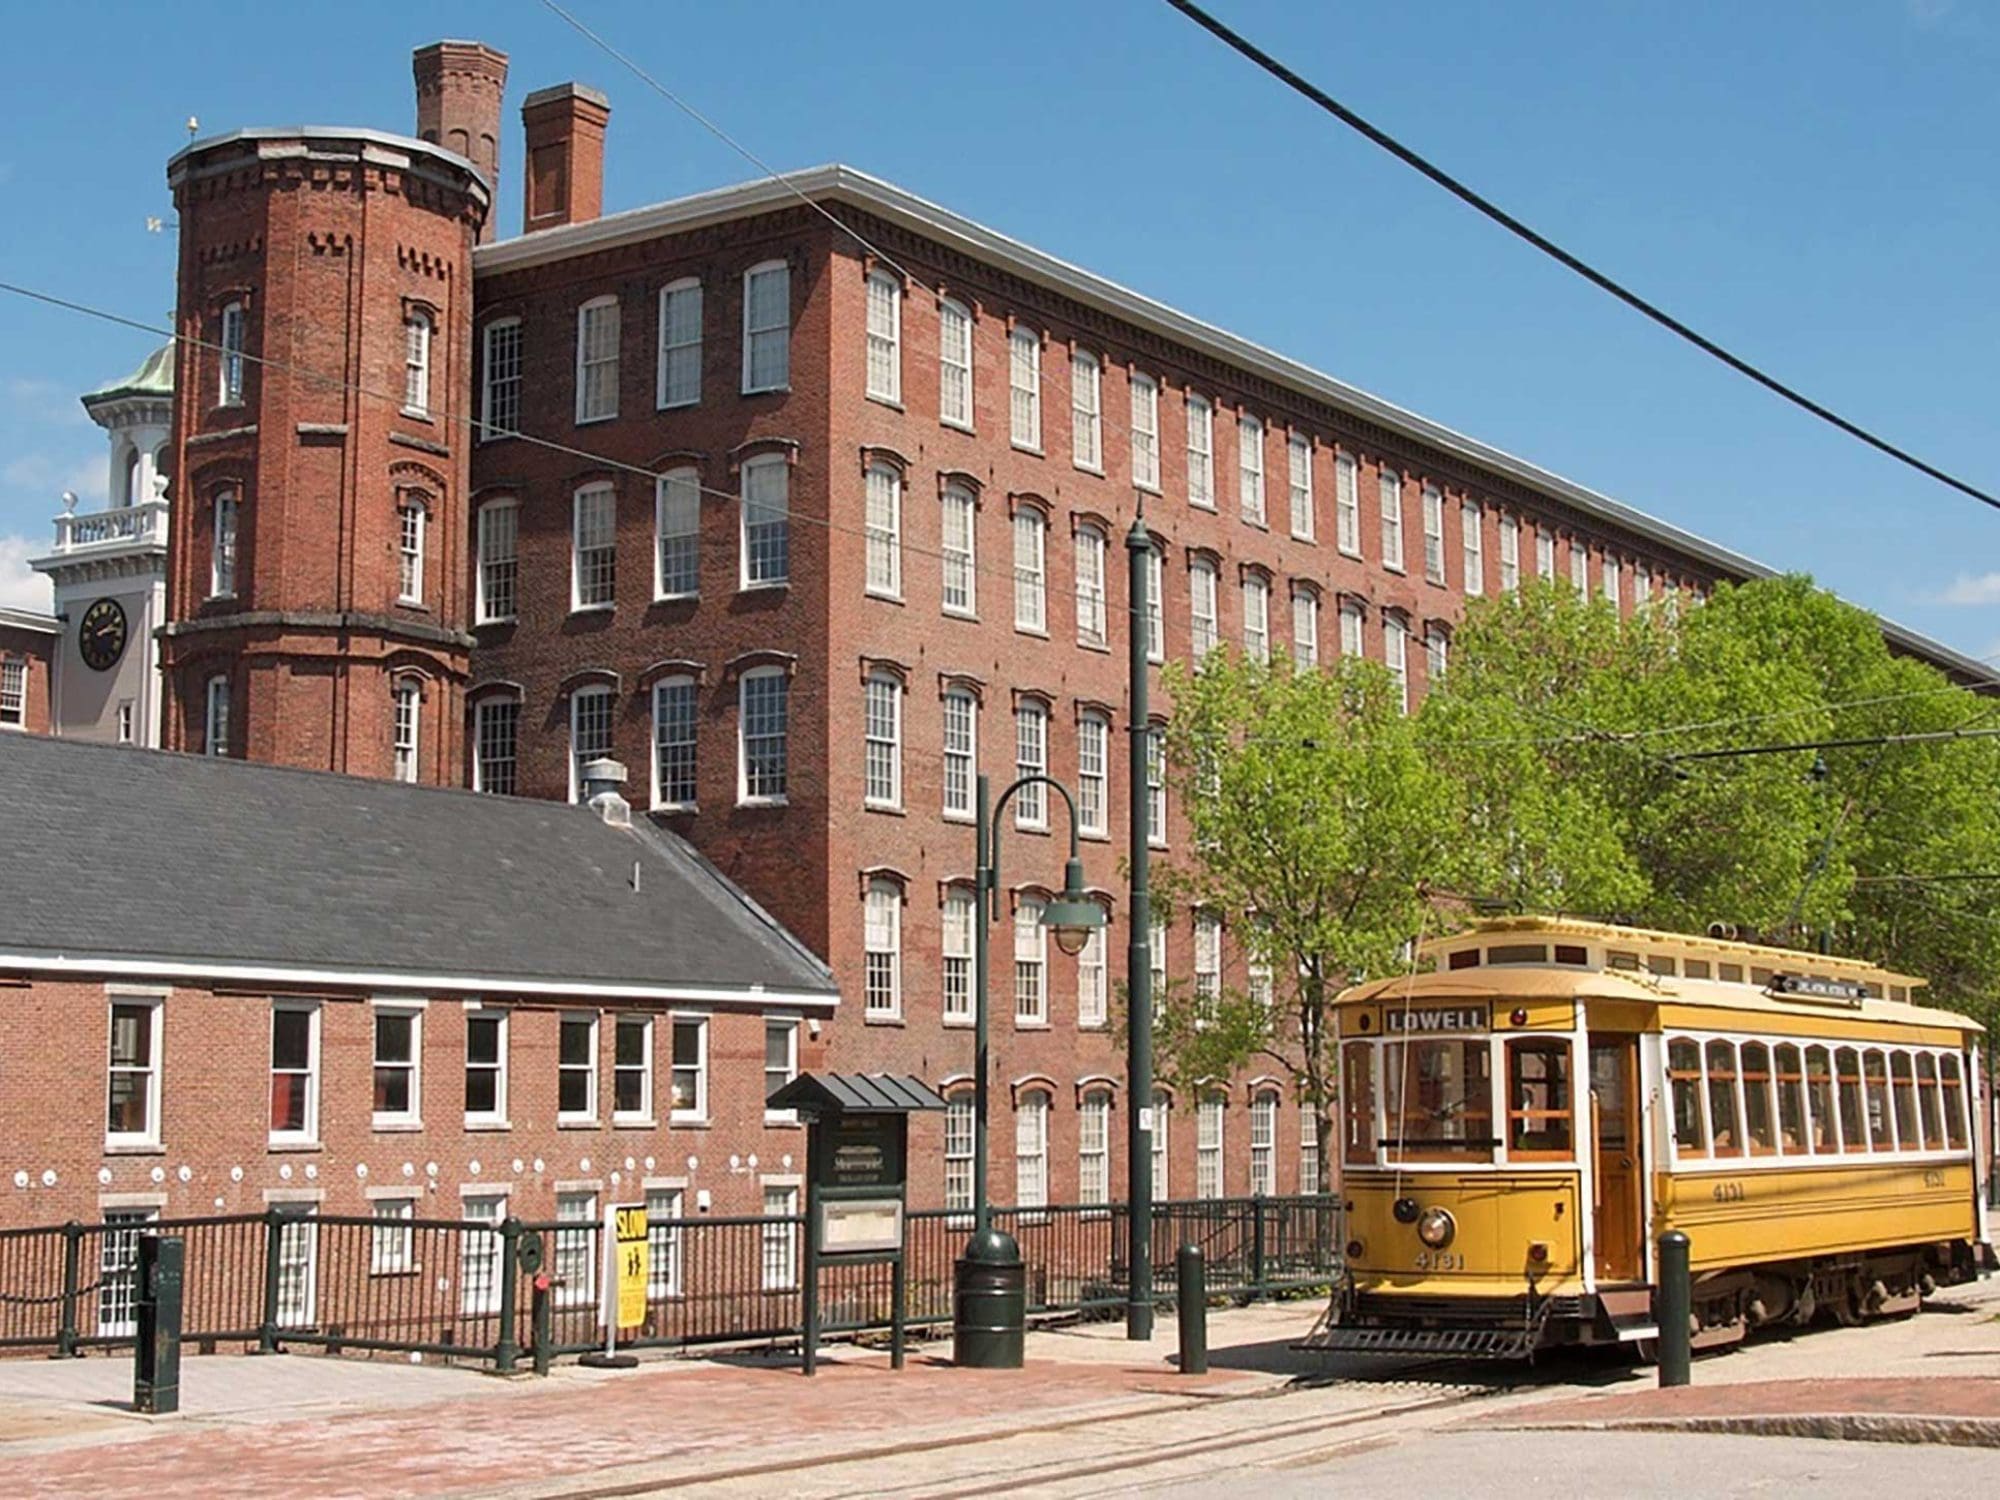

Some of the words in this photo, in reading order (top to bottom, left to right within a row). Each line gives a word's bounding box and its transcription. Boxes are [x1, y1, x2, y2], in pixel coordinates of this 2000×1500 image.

[1389, 1010, 1484, 1030] LOWELL
[1712, 1181, 1745, 1202] 4131
[615, 1209, 647, 1239] SLOW
[1415, 1252, 1465, 1270] 4131
